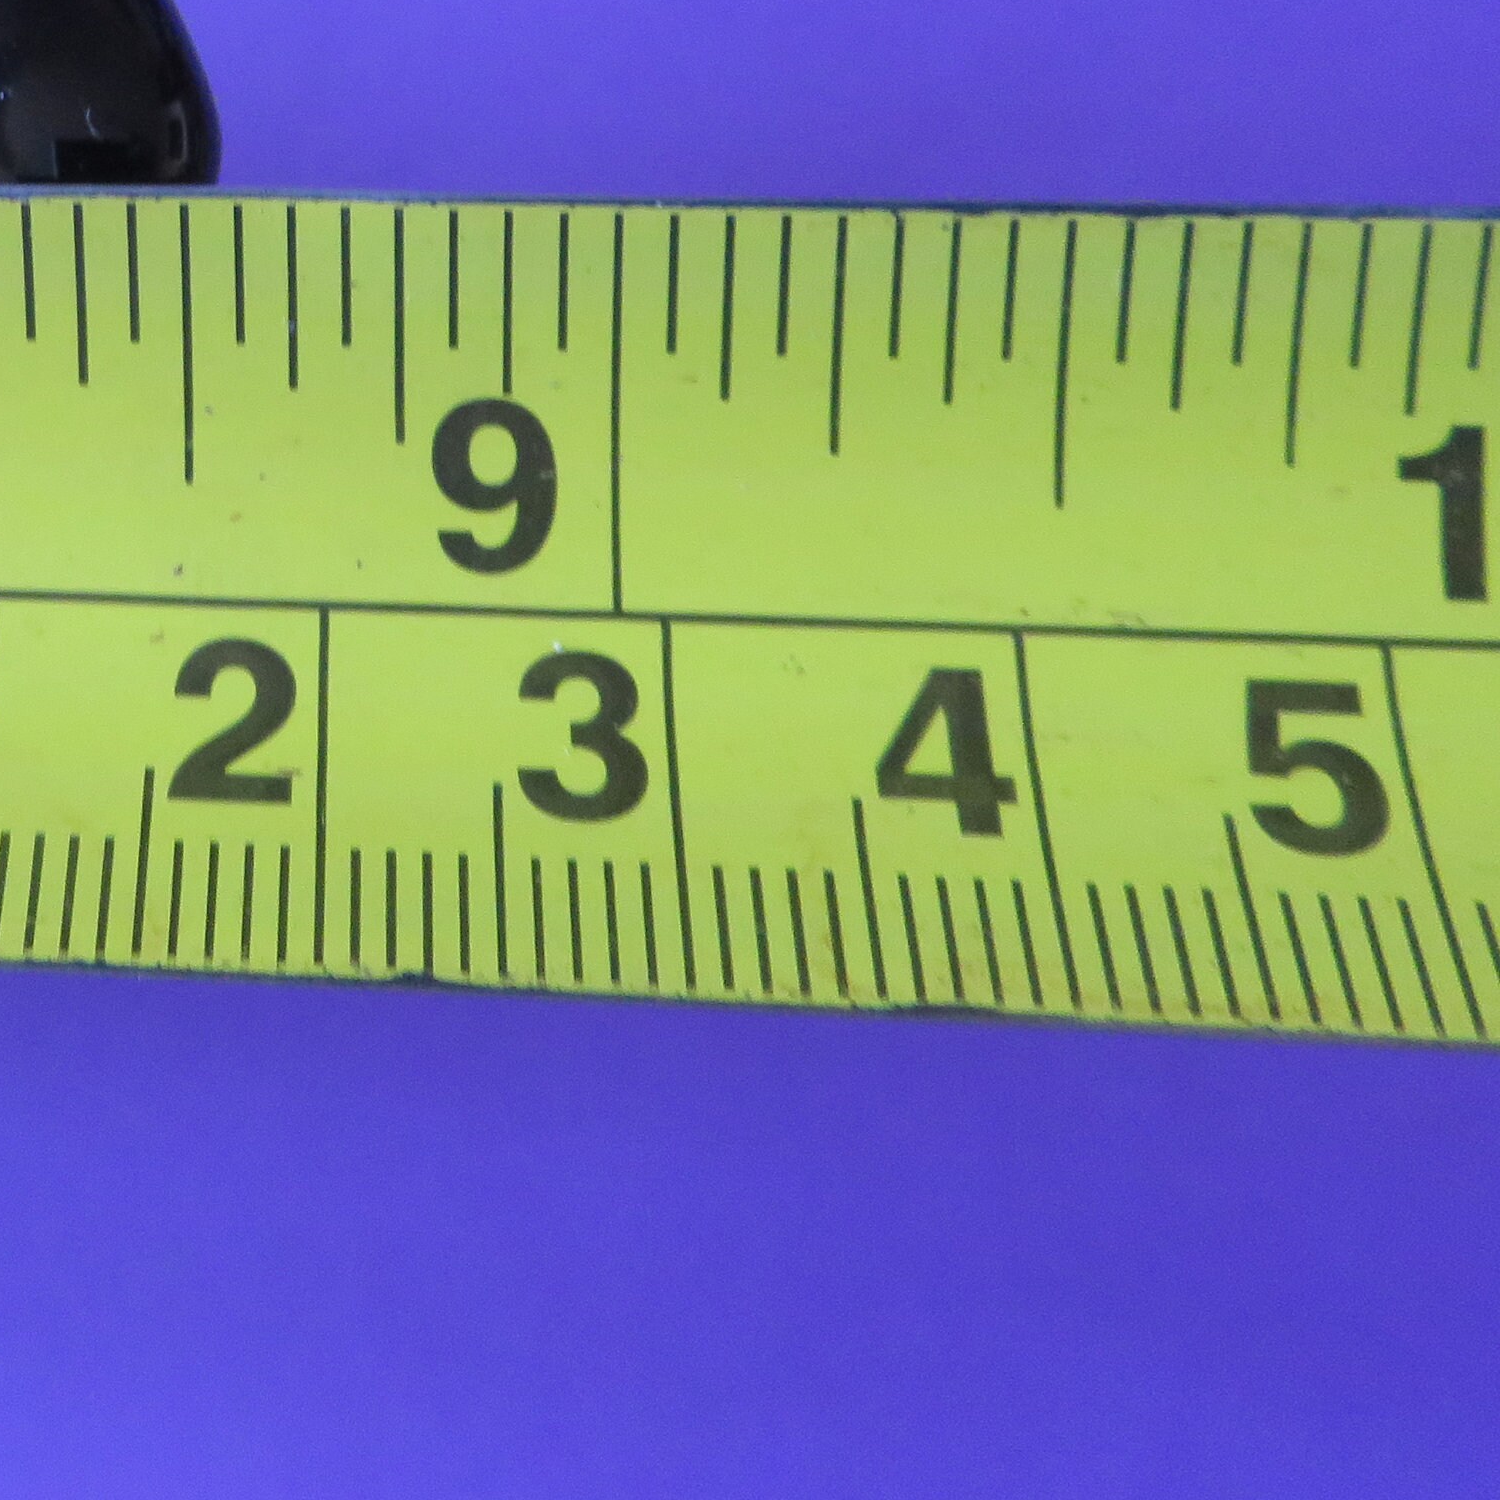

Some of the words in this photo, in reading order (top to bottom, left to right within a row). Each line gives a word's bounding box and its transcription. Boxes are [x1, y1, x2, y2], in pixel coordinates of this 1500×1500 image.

[430, 397, 558, 575] 9
[167, 638, 298, 804] 2
[516, 651, 650, 822] 3
[875, 666, 1018, 838] 4
[1245, 677, 1391, 858] 5
